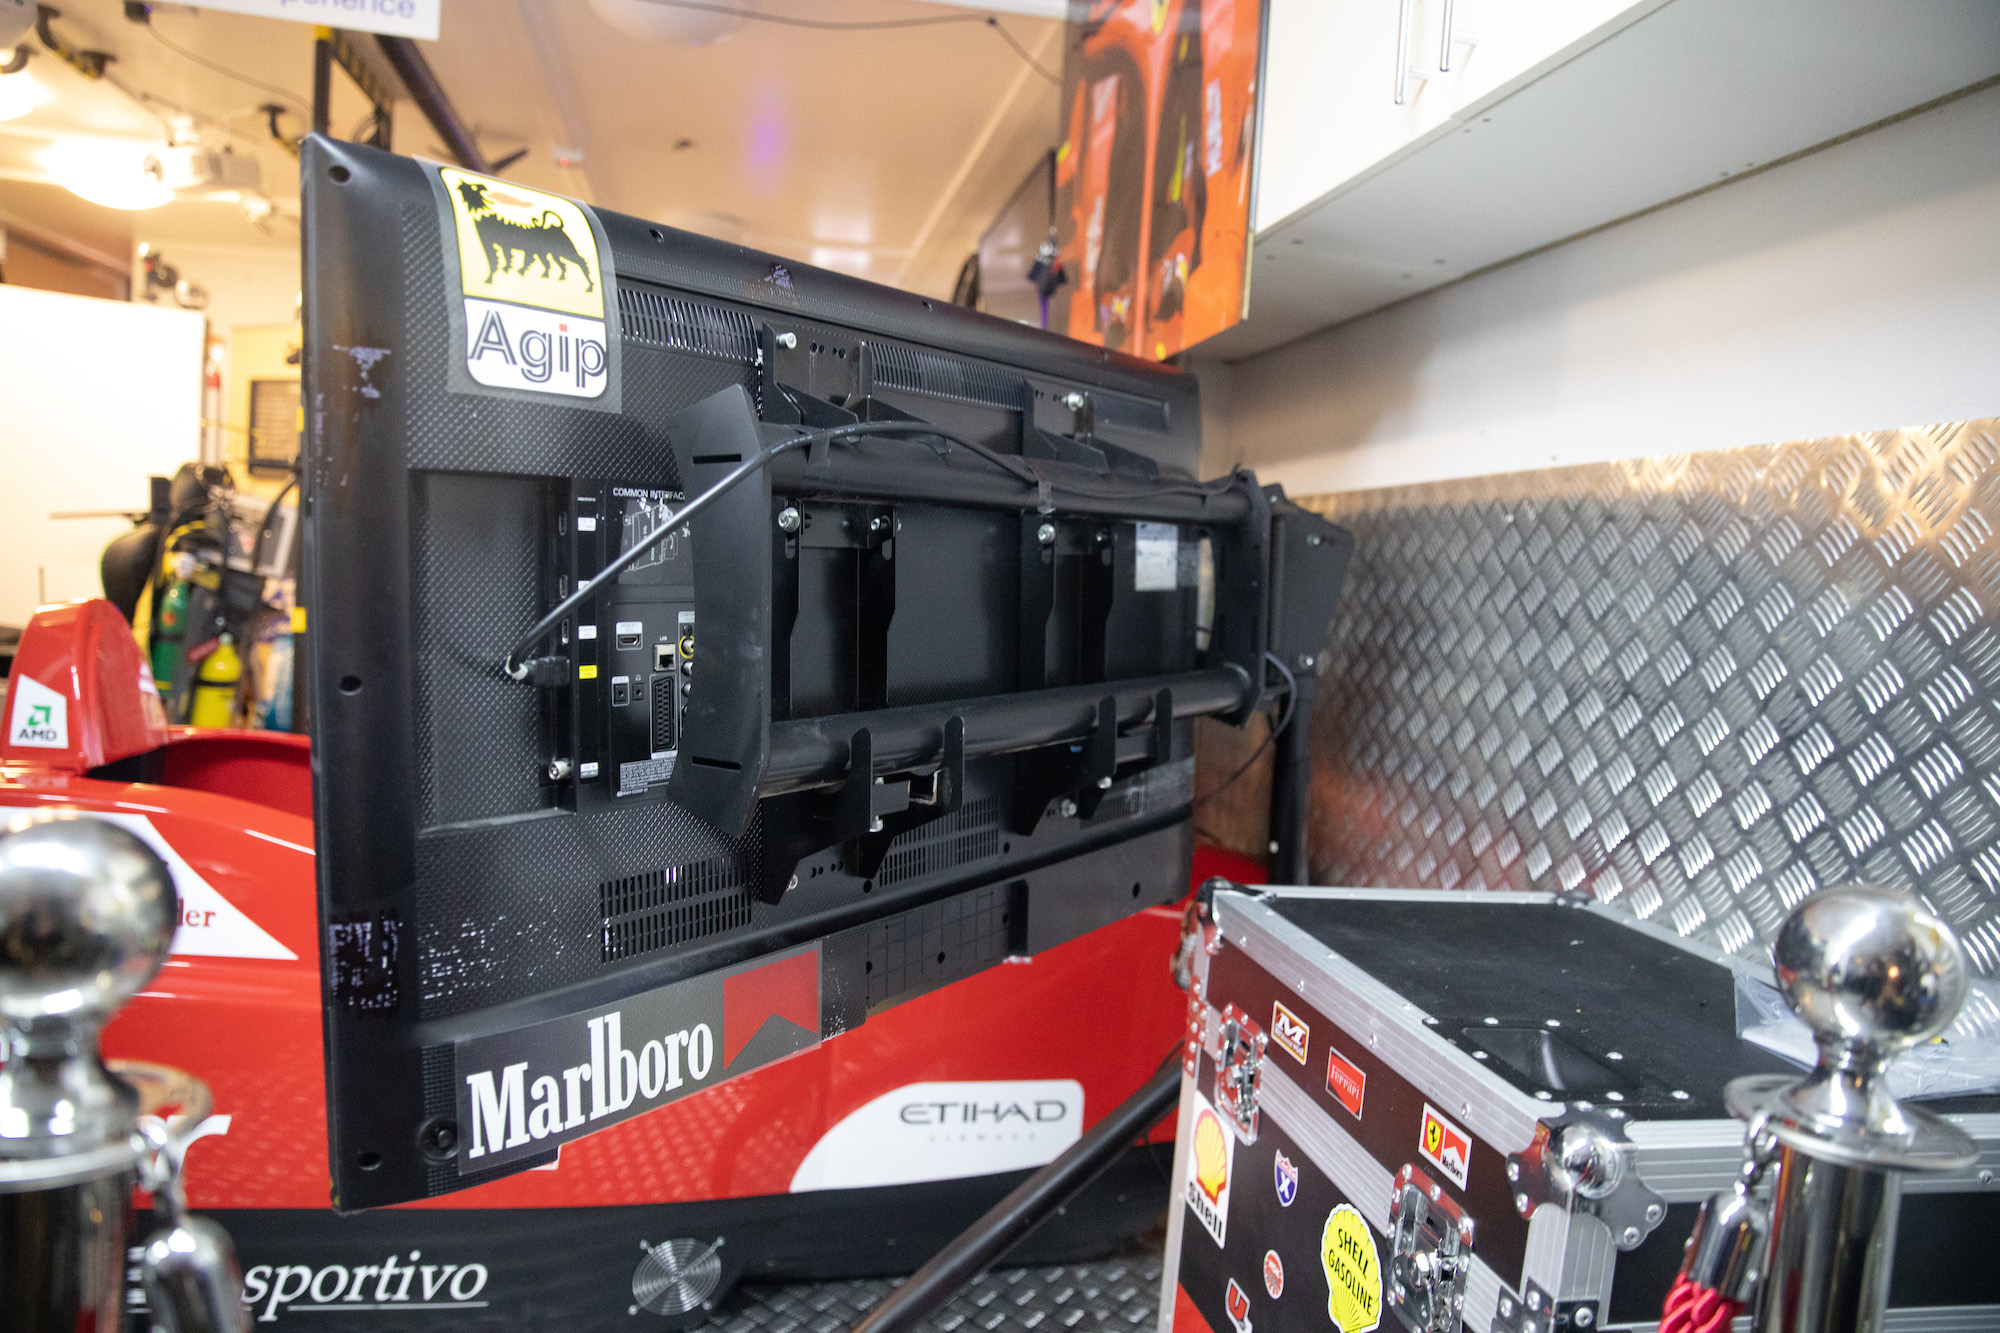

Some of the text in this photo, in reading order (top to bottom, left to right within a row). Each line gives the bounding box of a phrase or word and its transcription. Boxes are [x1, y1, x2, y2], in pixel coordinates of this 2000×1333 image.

[468, 310, 607, 388] Agip
[612, 487, 686, 500] COMMON INTERFAC
[18, 728, 57, 742] AMD
[1276, 1012, 1306, 1046] M
[466, 1011, 714, 1159] Marlboro
[1330, 1064, 1360, 1100] Ferrari
[900, 1100, 1067, 1125] ETIHAD
[1441, 1154, 1463, 1181] Marlboro
[1189, 1181, 1222, 1240] Shell
[1338, 1228, 1369, 1280] SHELL
[240, 1249, 489, 1322] sportivo
[1328, 1249, 1373, 1316] GASOLINE
